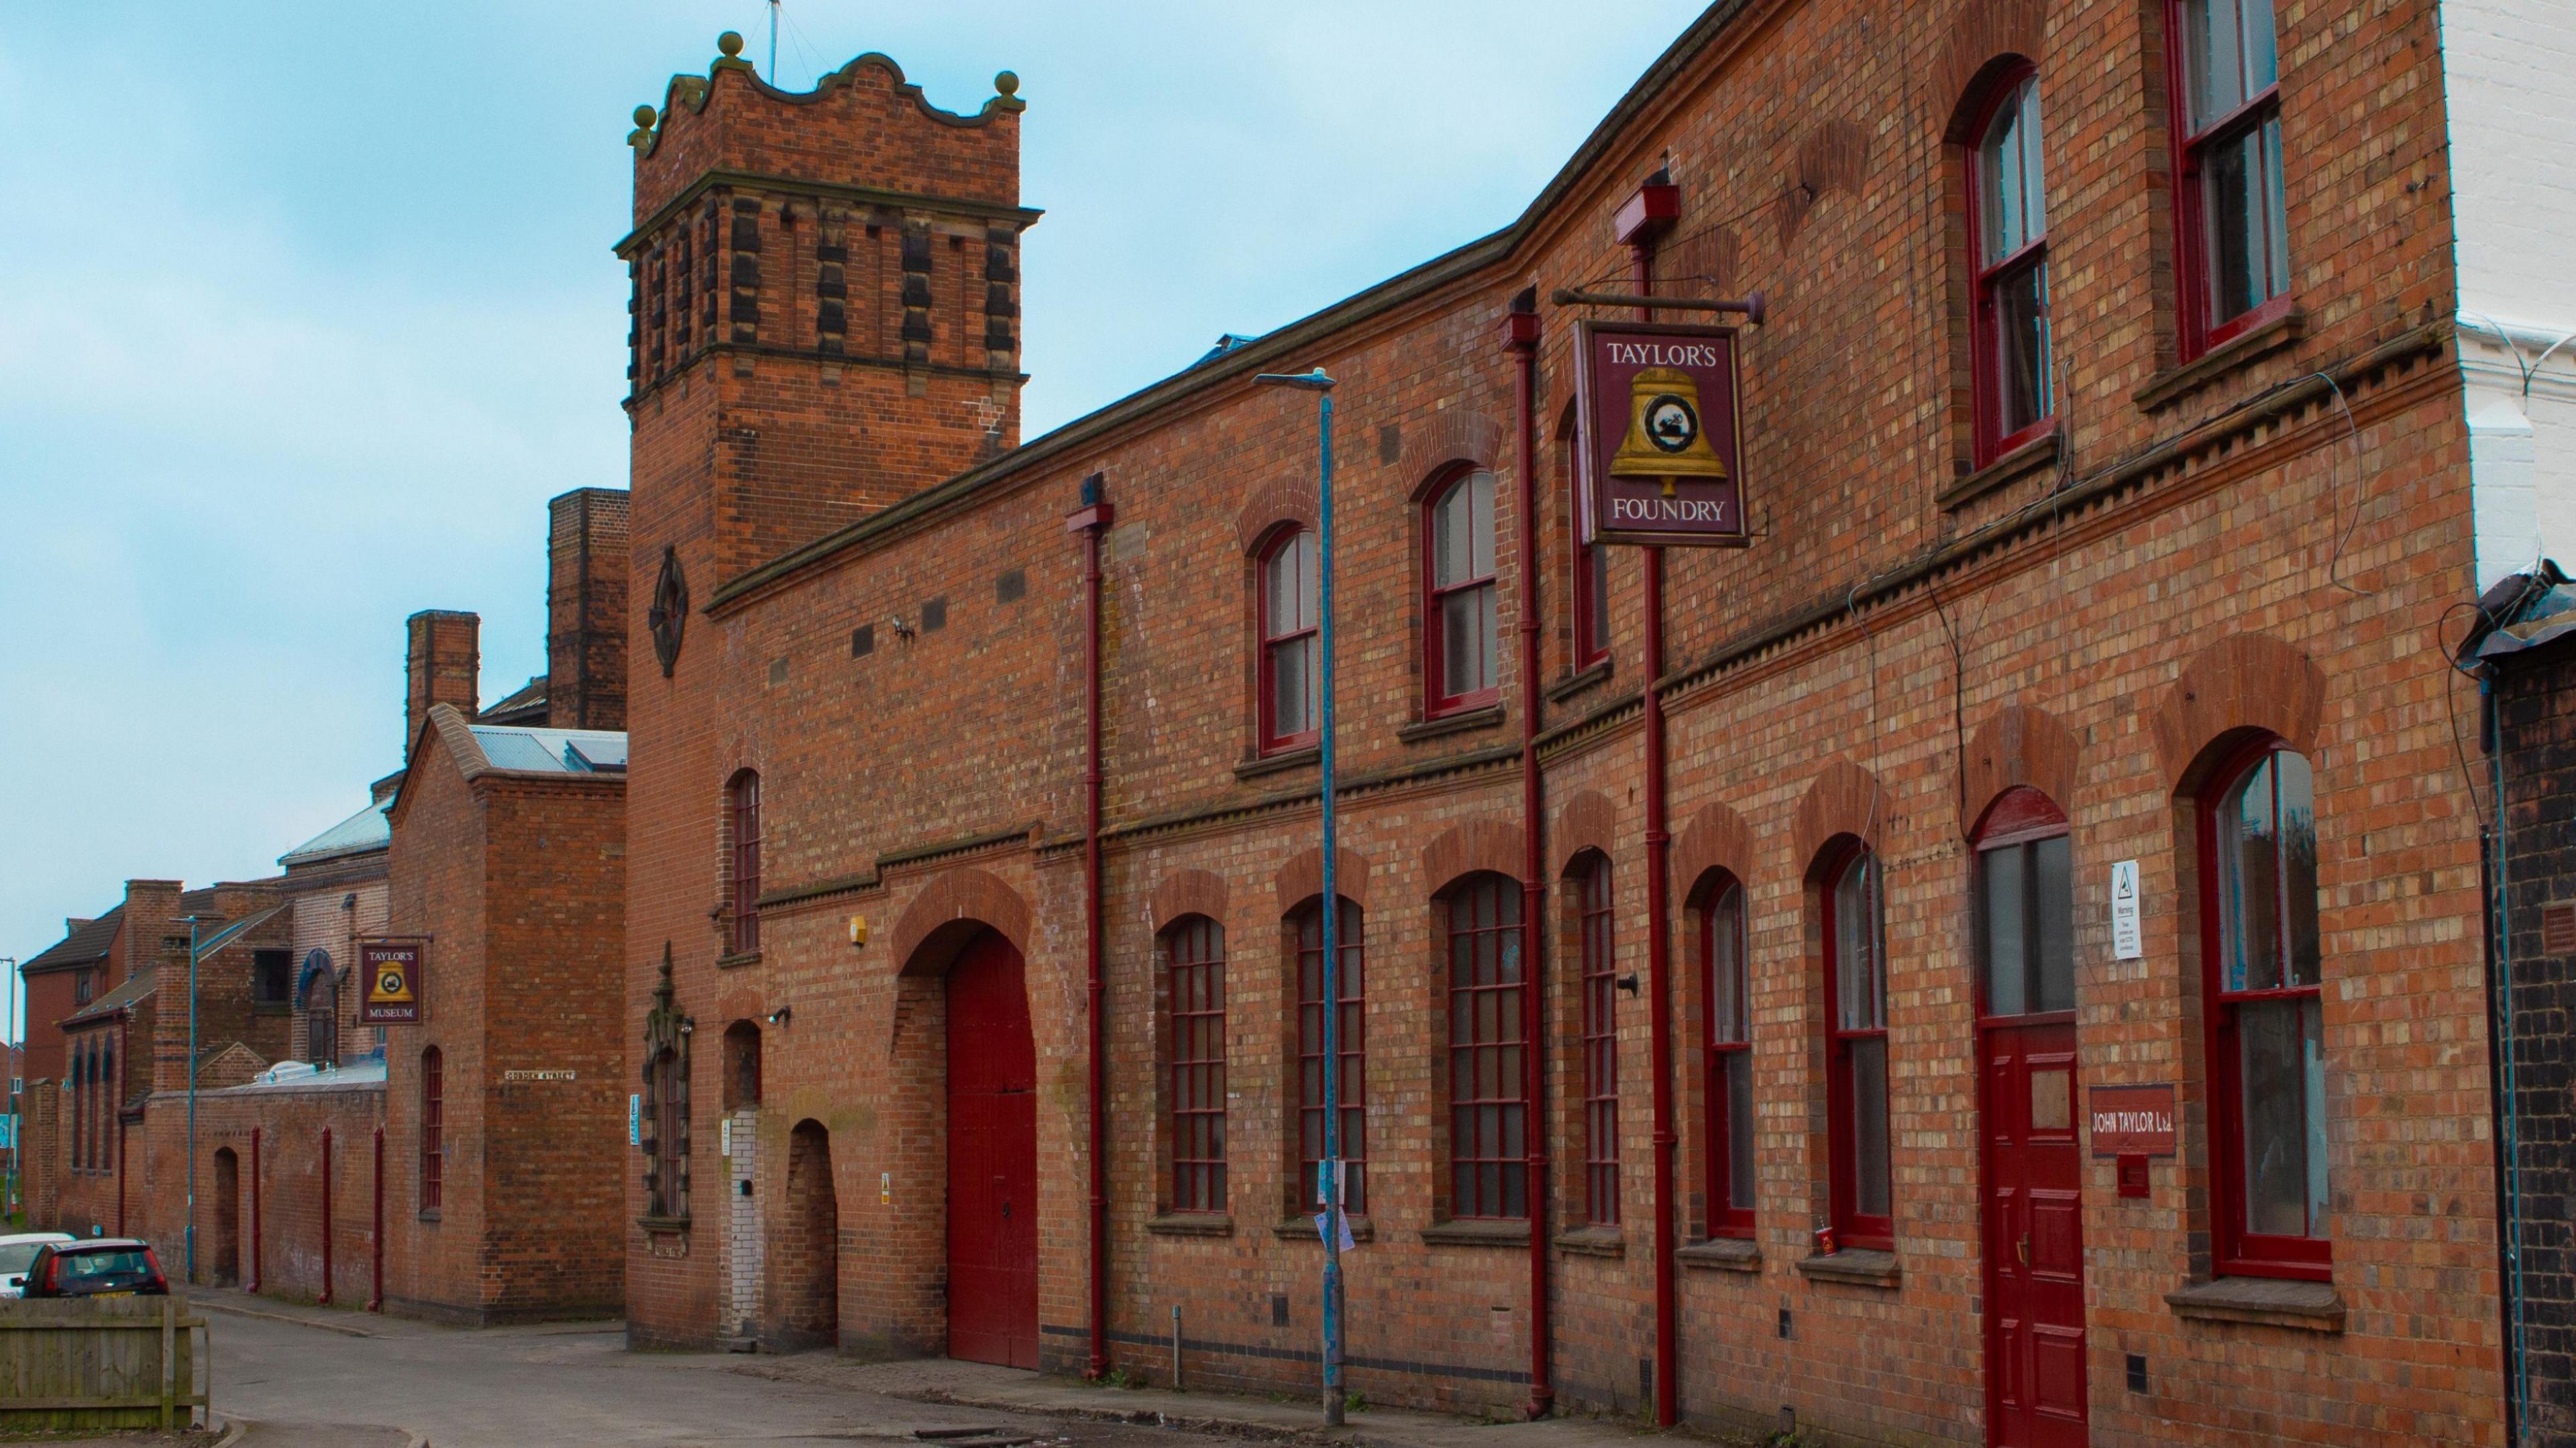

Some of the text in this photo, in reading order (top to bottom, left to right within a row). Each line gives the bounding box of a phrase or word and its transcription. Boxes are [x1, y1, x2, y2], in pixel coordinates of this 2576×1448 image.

[1607, 343, 1717, 367] TAYLOR'S
[1613, 498, 1725, 521] FOUNDRY
[369, 952, 414, 960] TAYLOR'S
[370, 1009, 413, 1017] MUSEUM
[2092, 1112, 2116, 1133] JOHN
[2118, 1111, 2153, 1133] TAYLOR
